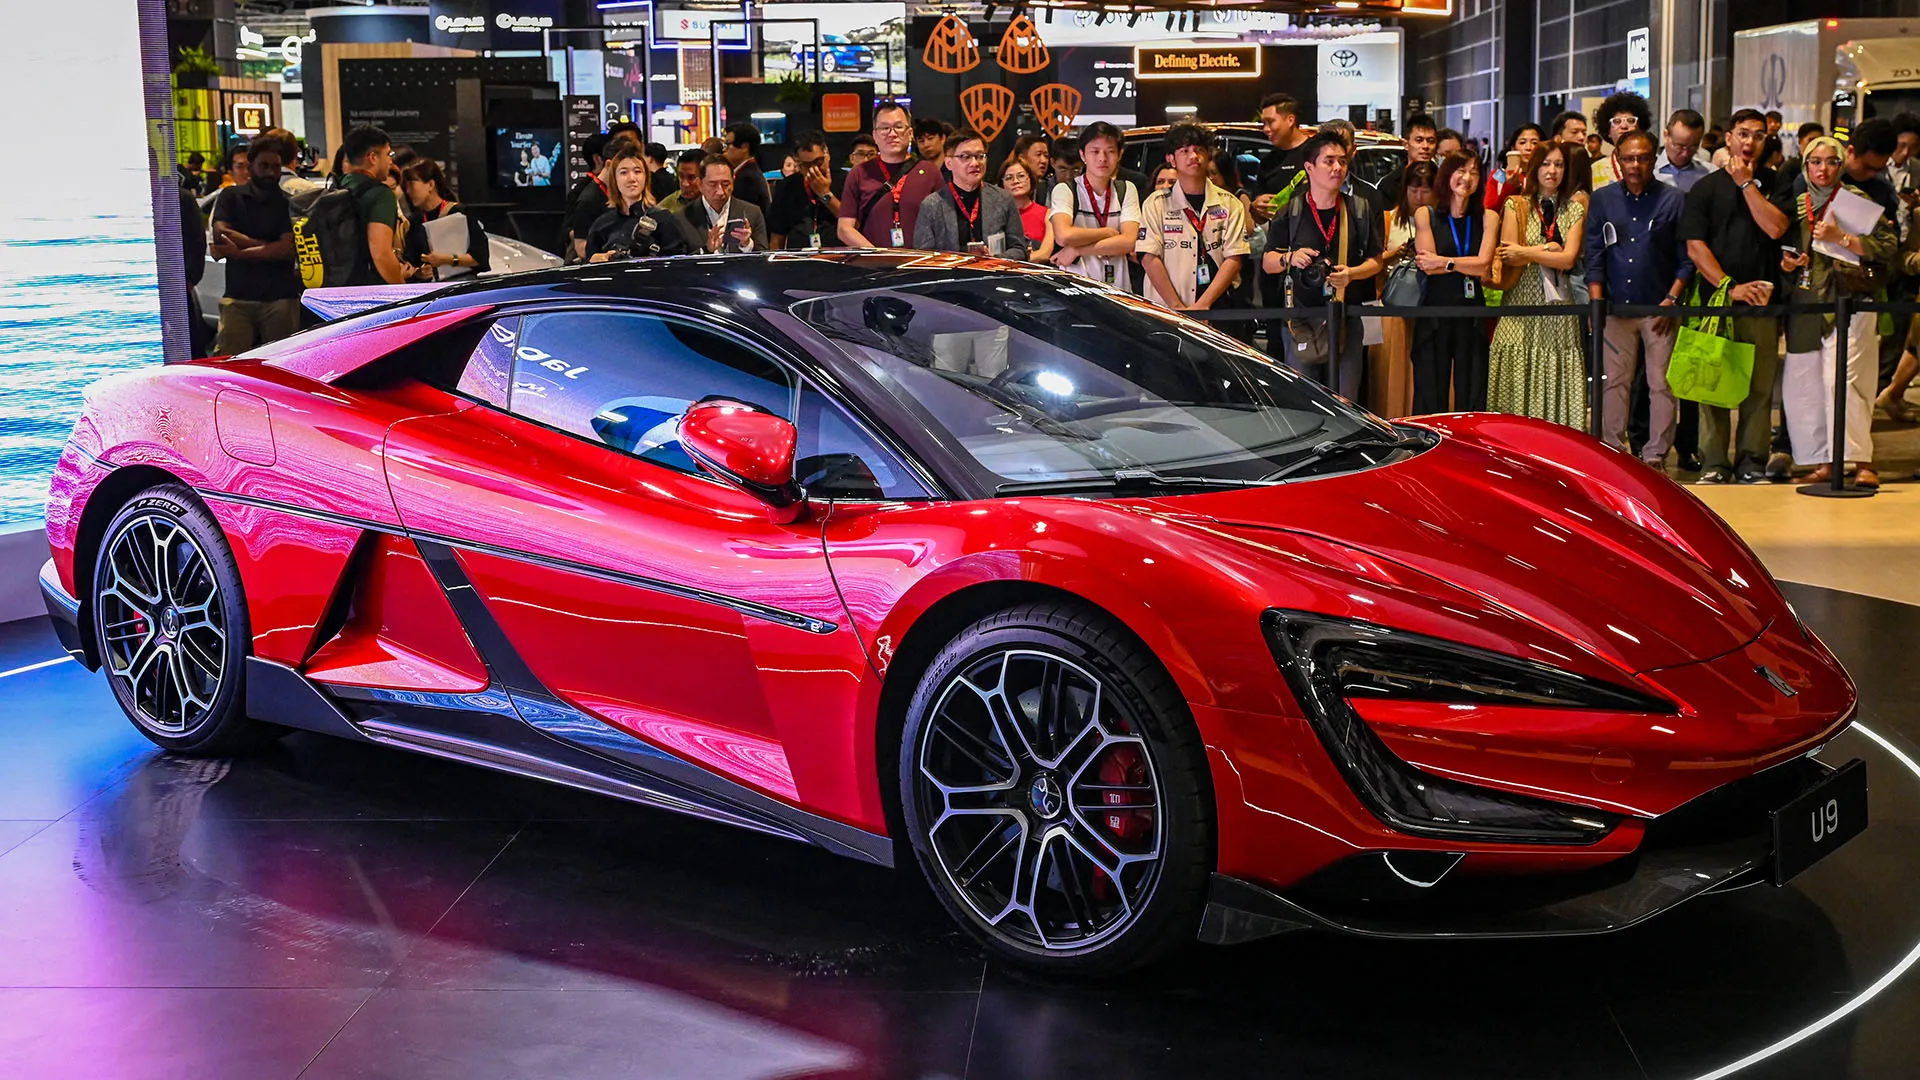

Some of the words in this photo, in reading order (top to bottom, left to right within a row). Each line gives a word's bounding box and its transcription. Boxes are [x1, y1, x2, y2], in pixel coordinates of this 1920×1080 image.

[692, 20, 733, 30] SUKI
[1154, 53, 1198, 70] Defining
[1199, 53, 1241, 68] Electric.
[1094, 77, 1137, 98] 37:
[304, 233, 323, 264] THE
[138, 500, 147, 508] P
[147, 499, 181, 513] ZERO
[1811, 799, 1838, 843] U9
